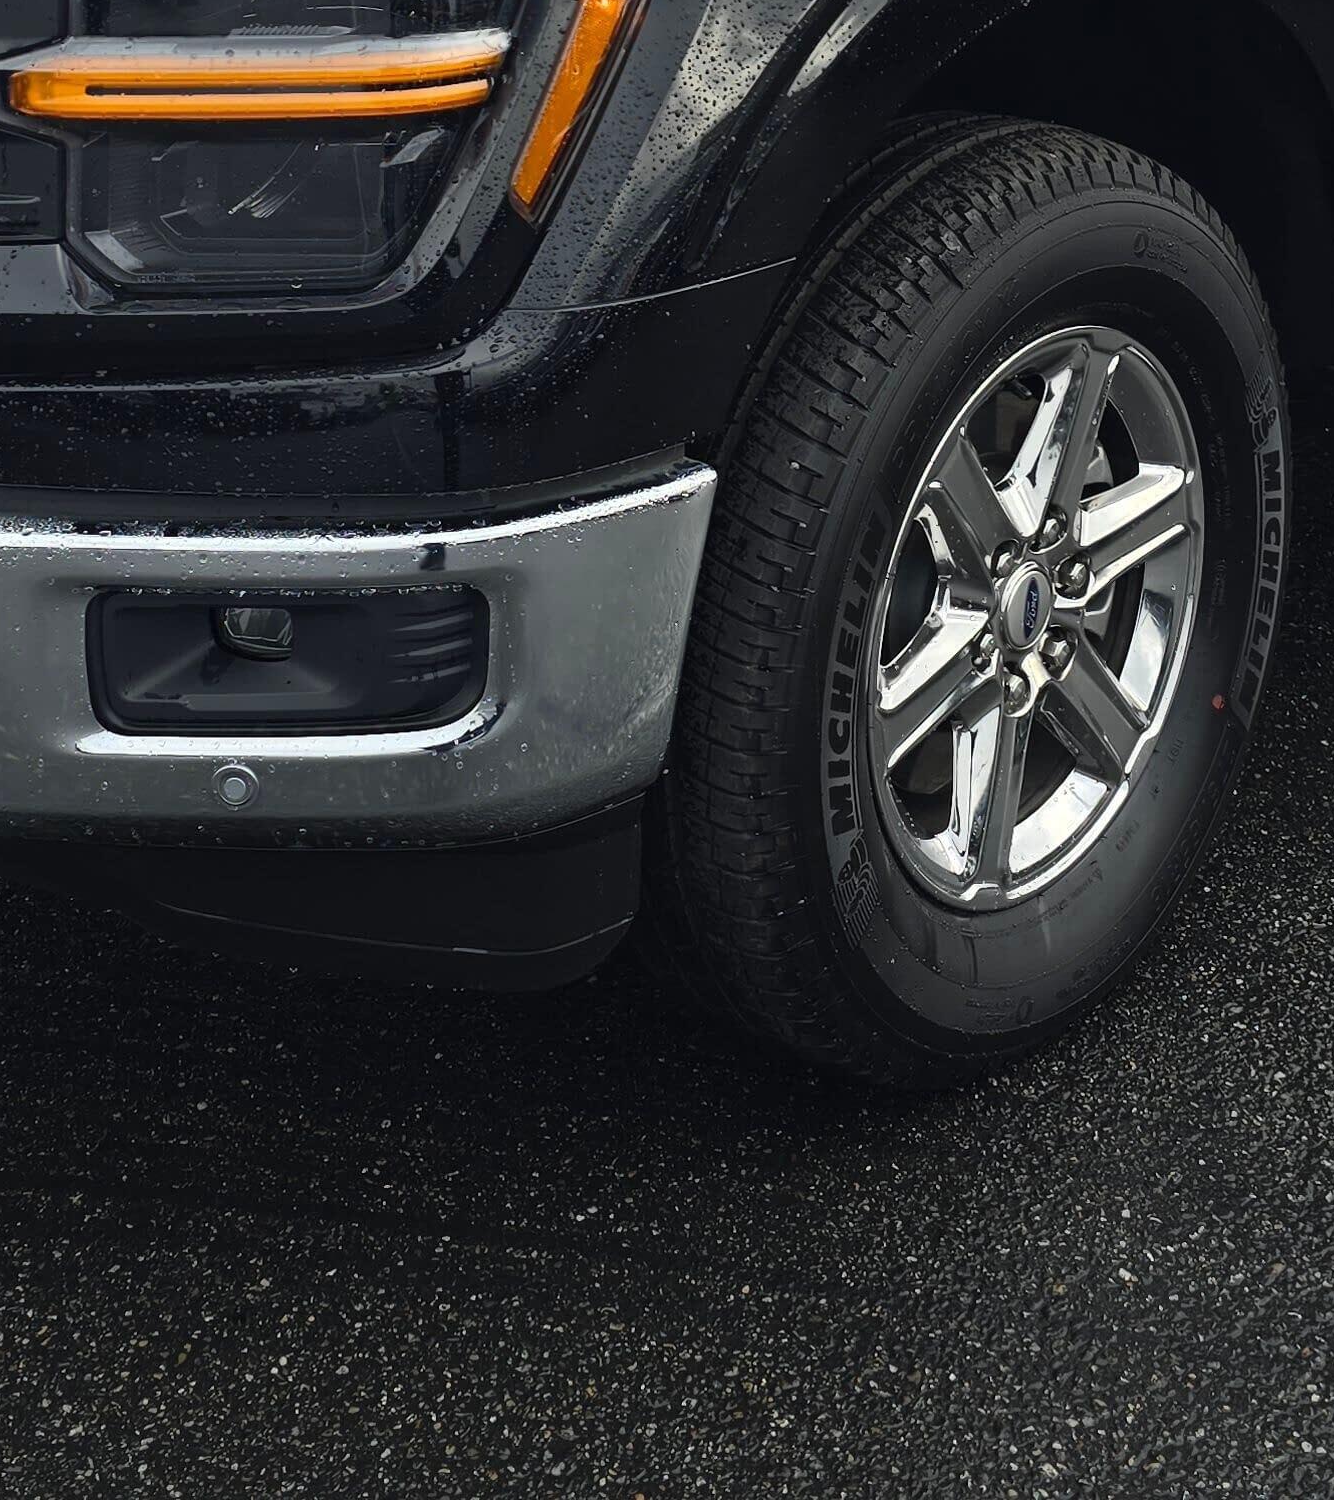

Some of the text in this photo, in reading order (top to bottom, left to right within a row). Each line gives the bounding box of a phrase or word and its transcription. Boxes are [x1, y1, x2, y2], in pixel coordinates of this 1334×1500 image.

[827, 509, 888, 837] MICHELIN
[1025, 590, 1038, 629] Ford
[1237, 449, 1283, 714] MICHELIN
